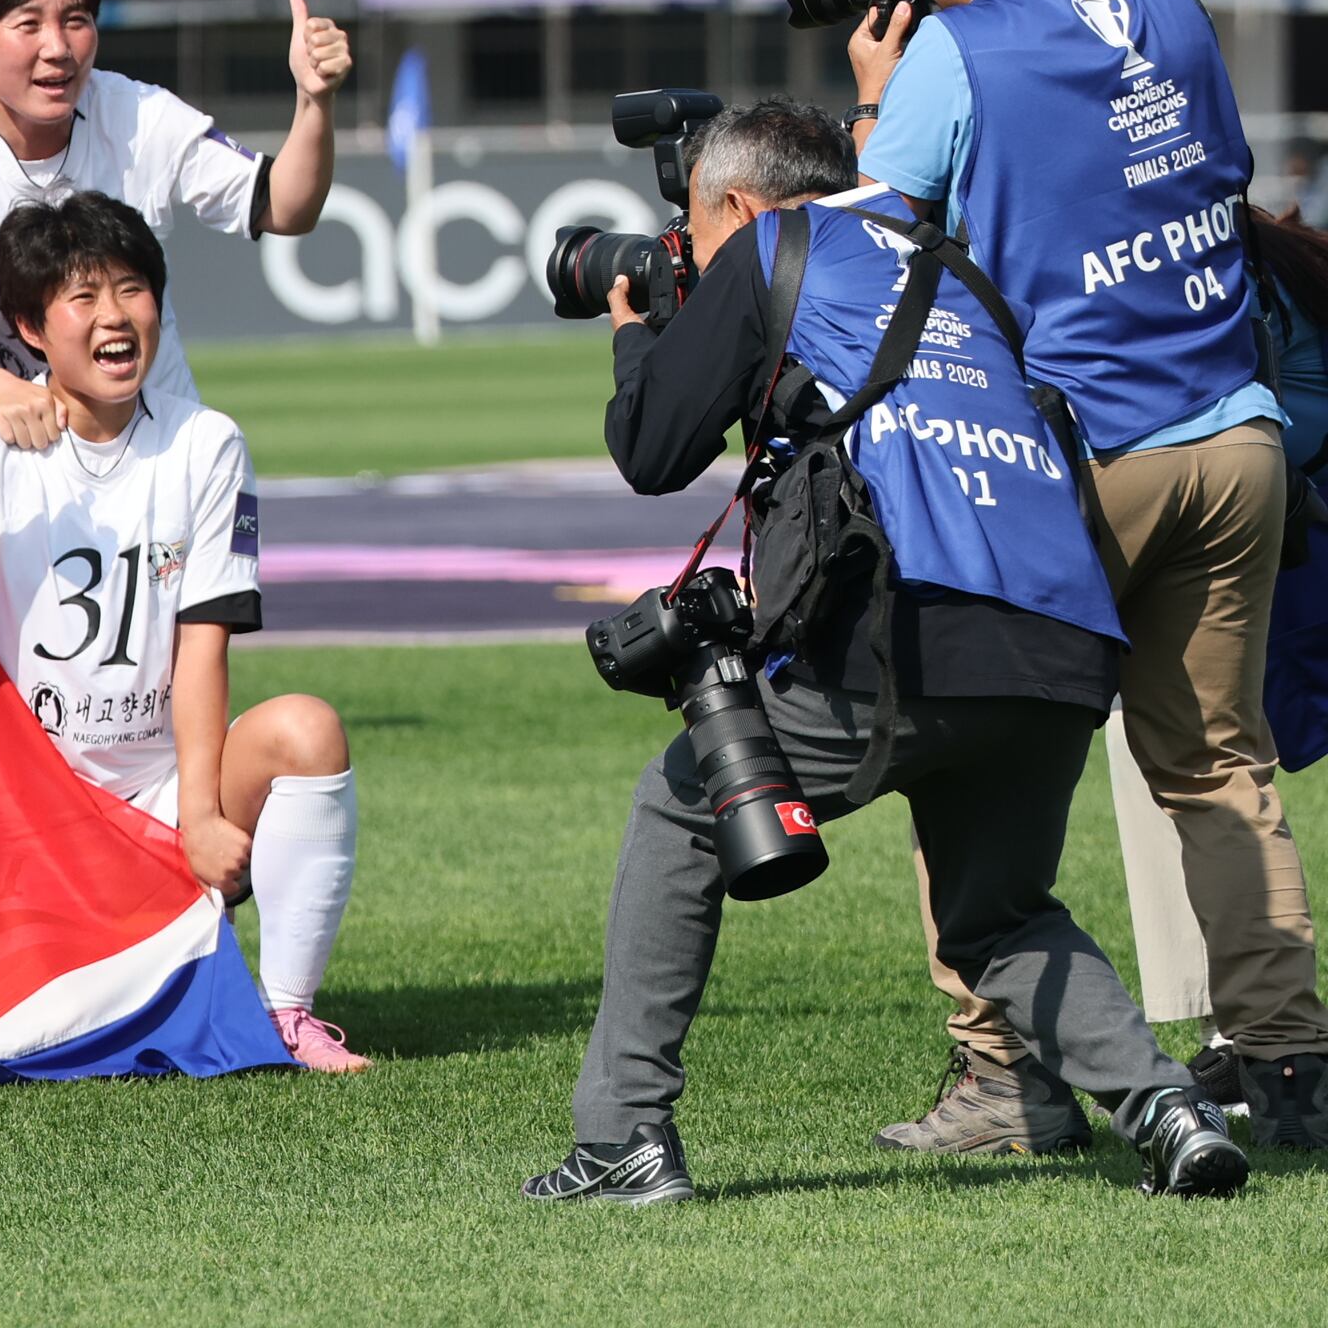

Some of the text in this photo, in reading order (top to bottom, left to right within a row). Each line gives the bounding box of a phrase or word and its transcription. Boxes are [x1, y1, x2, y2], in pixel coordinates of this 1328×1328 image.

[1110, 79, 1176, 114] WOMEN'S
[1132, 76, 1153, 93] AFC
[1108, 91, 1188, 131] CHAMPIONS
[1128, 113, 1182, 143] LEAGUE
[1123, 141, 1207, 188] FINALS 2026
[1082, 194, 1239, 295] AFC PHOT
[1184, 266, 1227, 311] 04
[946, 363, 988, 389] 2026
[235, 514, 256, 532] AFC
[33, 543, 142, 667] 31
[72, 732, 135, 745] NAEGOHYANG
[610, 1144, 665, 1185] SALOMON
